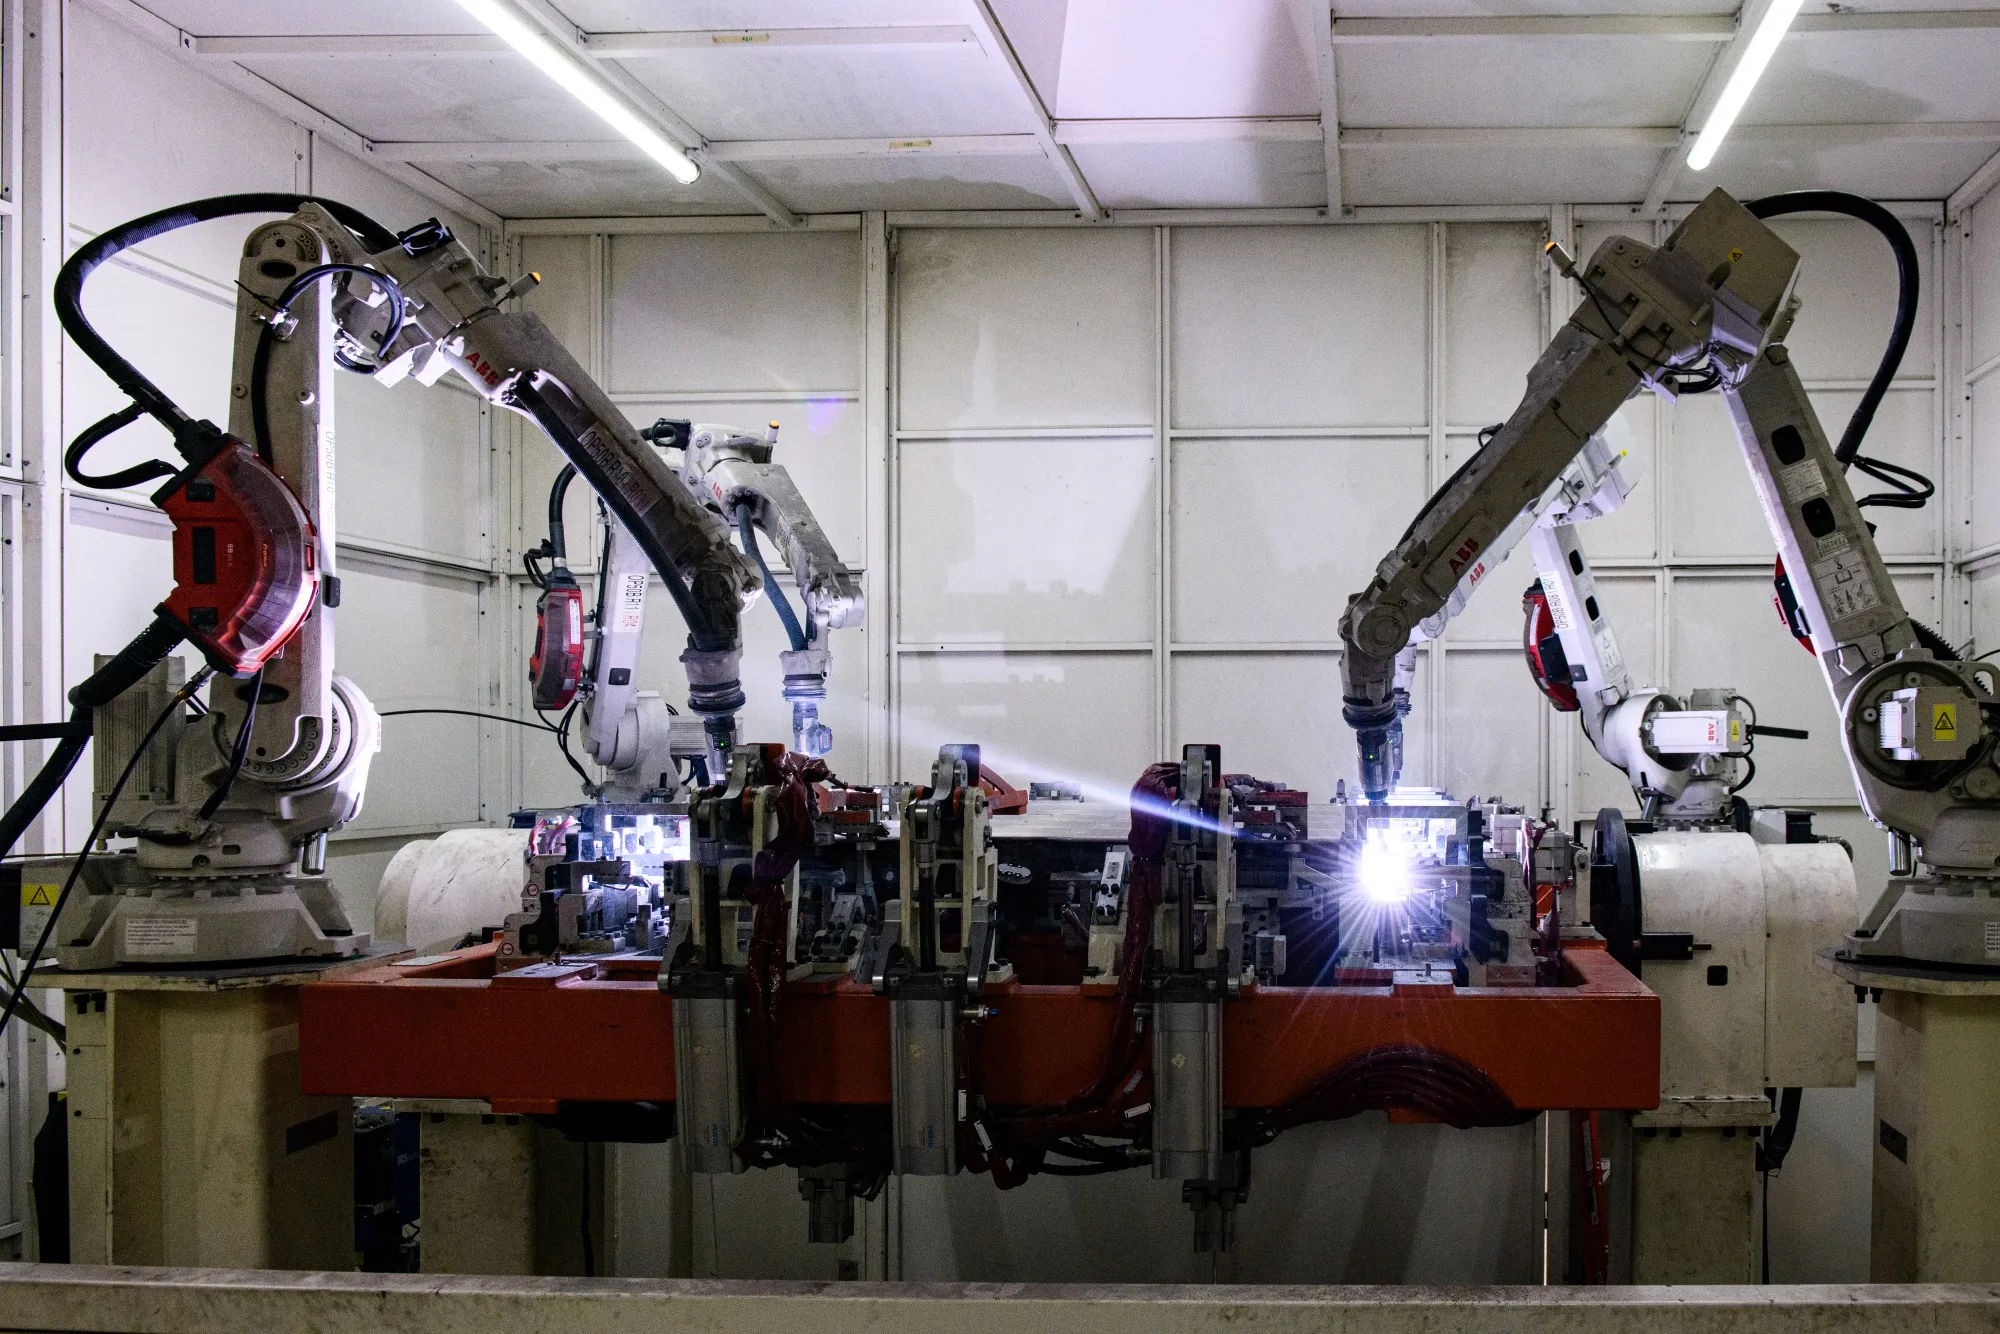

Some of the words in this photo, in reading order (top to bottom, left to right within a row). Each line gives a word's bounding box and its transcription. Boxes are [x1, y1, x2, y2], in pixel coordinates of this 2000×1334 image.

[464, 352, 499, 385] ABB
[1449, 538, 1479, 575] ABB
[626, 575, 644, 597] OP50B
[1470, 562, 1485, 586] ABB
[1551, 607, 1569, 629] OP50B
